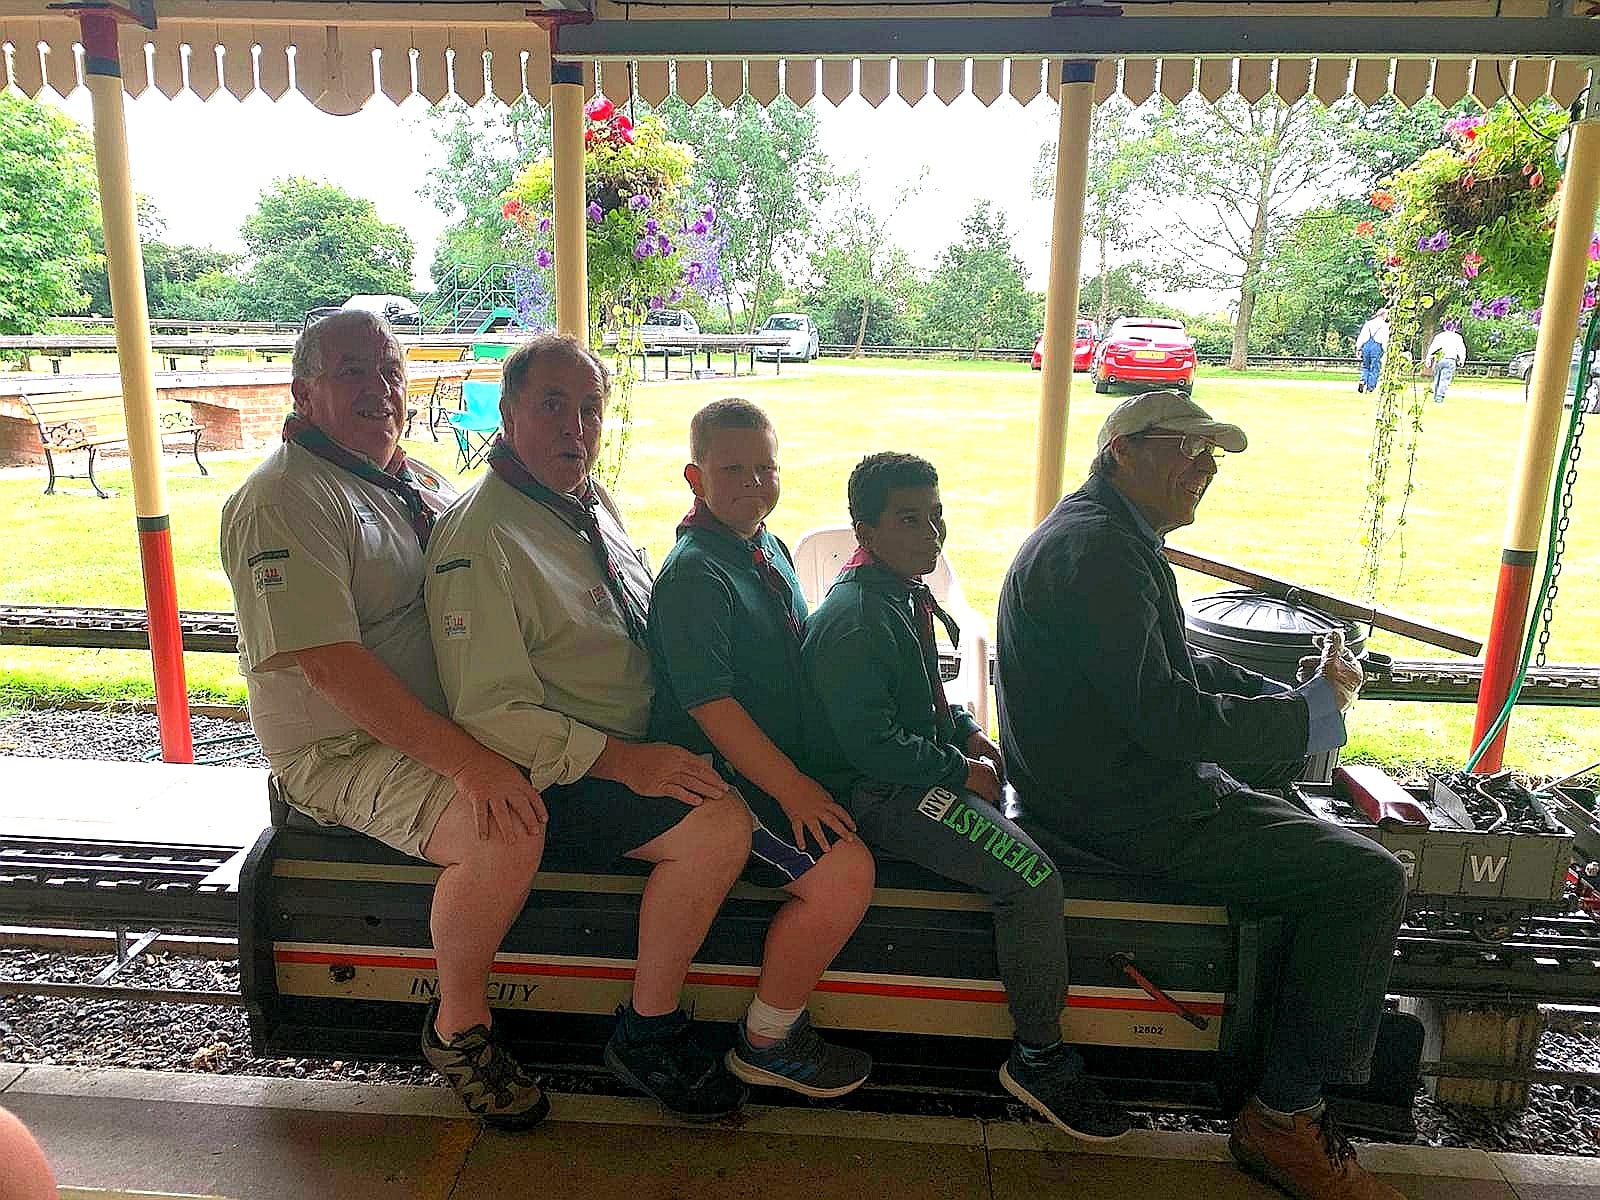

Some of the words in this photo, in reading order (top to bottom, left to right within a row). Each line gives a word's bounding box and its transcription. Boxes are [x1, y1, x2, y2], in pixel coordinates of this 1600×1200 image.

[919, 787, 955, 820] NYC
[943, 803, 1053, 888] EVERLAST
[1470, 855, 1508, 882] W
[410, 977, 538, 1002] INCITY
